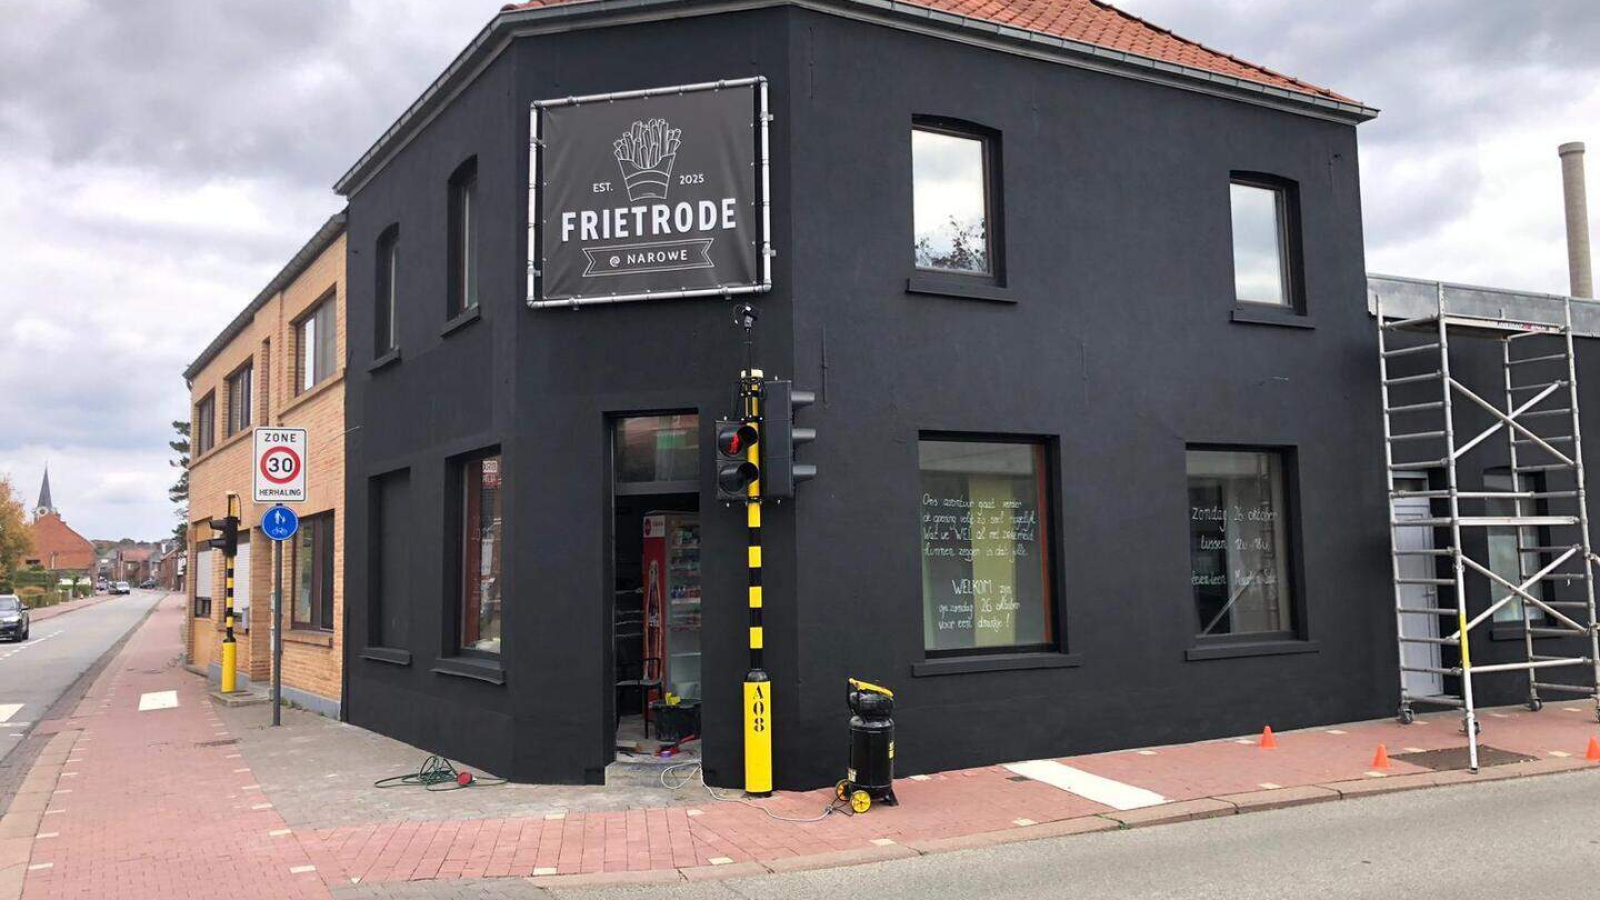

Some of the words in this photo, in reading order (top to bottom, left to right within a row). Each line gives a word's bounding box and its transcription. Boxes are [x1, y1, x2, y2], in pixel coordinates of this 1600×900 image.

[593, 182, 613, 193] EST.
[680, 174, 704, 184] 2025
[561, 198, 736, 242] FRIETRODE
[609, 256, 620, 268] @
[627, 250, 688, 264] NAROWE
[264, 433, 296, 442] ZONE
[268, 457, 293, 473] 30
[951, 579, 992, 595] WELKOM
[981, 599, 992, 613] 26
